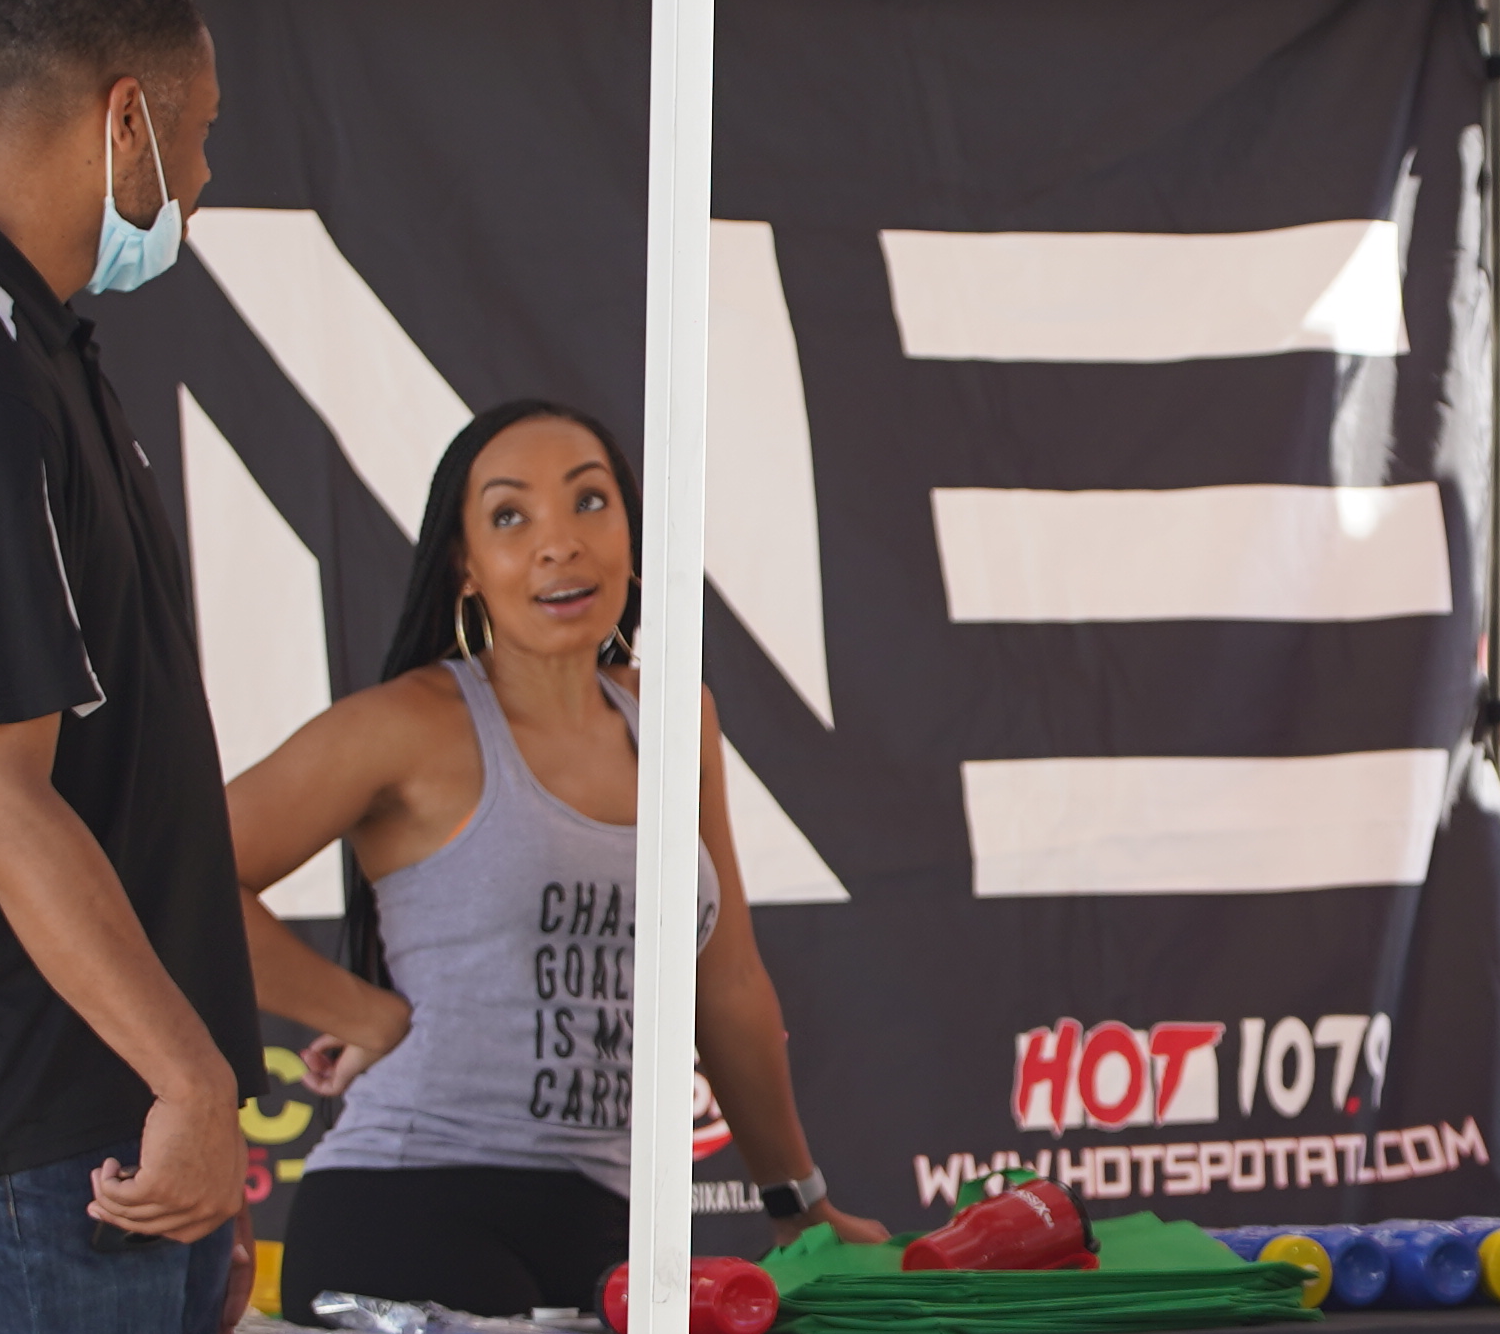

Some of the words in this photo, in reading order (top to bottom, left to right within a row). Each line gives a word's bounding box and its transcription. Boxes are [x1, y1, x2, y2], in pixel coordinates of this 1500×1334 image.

[535, 1007, 576, 1059] IS
[1011, 1016, 1226, 1137] HOT
[913, 1117, 1490, 1209] WWWHOTSPOTATL.COM
